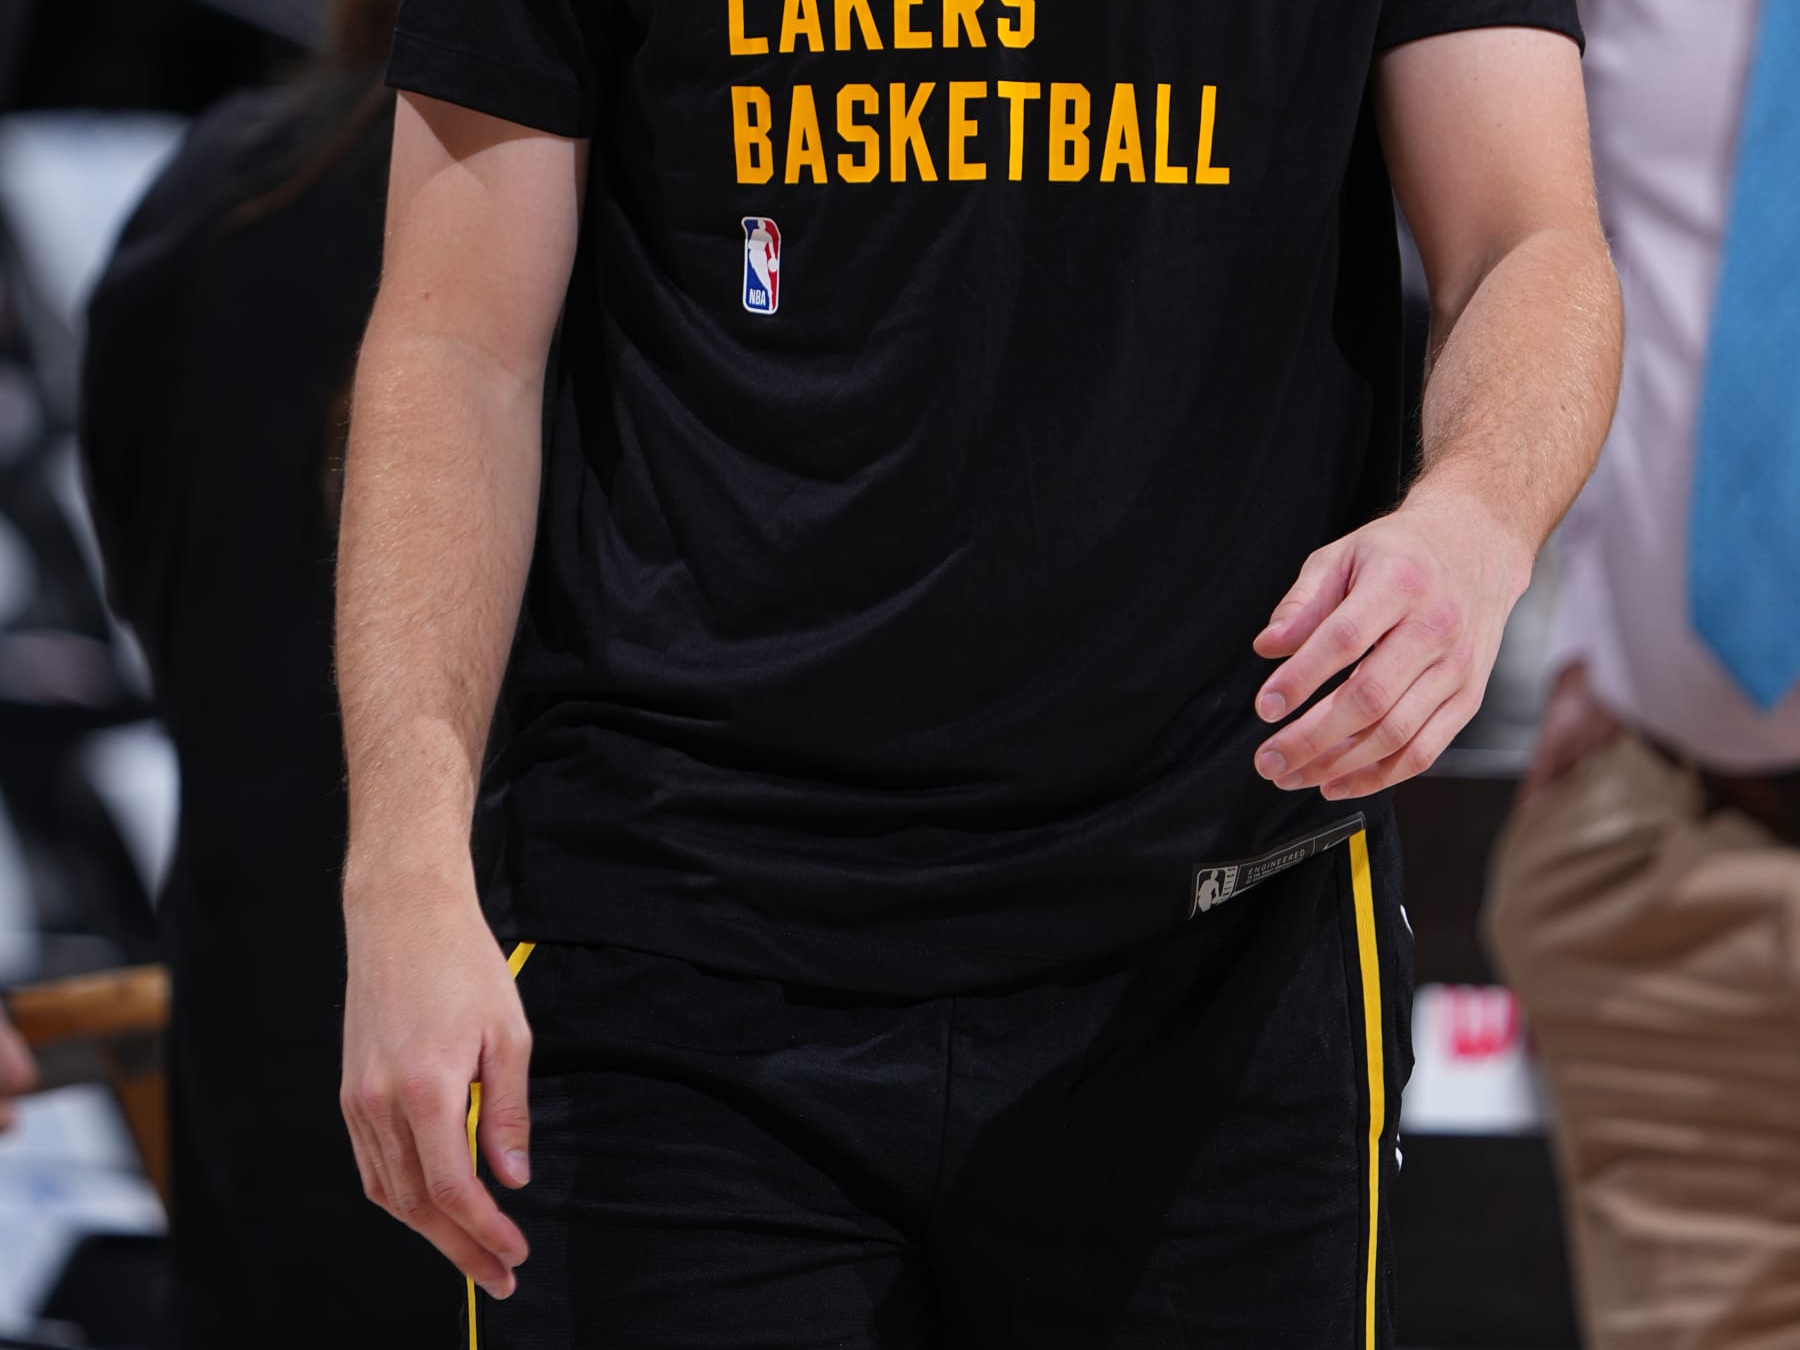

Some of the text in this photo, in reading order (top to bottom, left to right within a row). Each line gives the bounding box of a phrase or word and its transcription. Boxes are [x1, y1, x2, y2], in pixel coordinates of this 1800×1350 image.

[731, 81, 1230, 185] BASKETBALL
[749, 288, 767, 306] NBA
[1248, 849, 1306, 875] ENGINEERED
